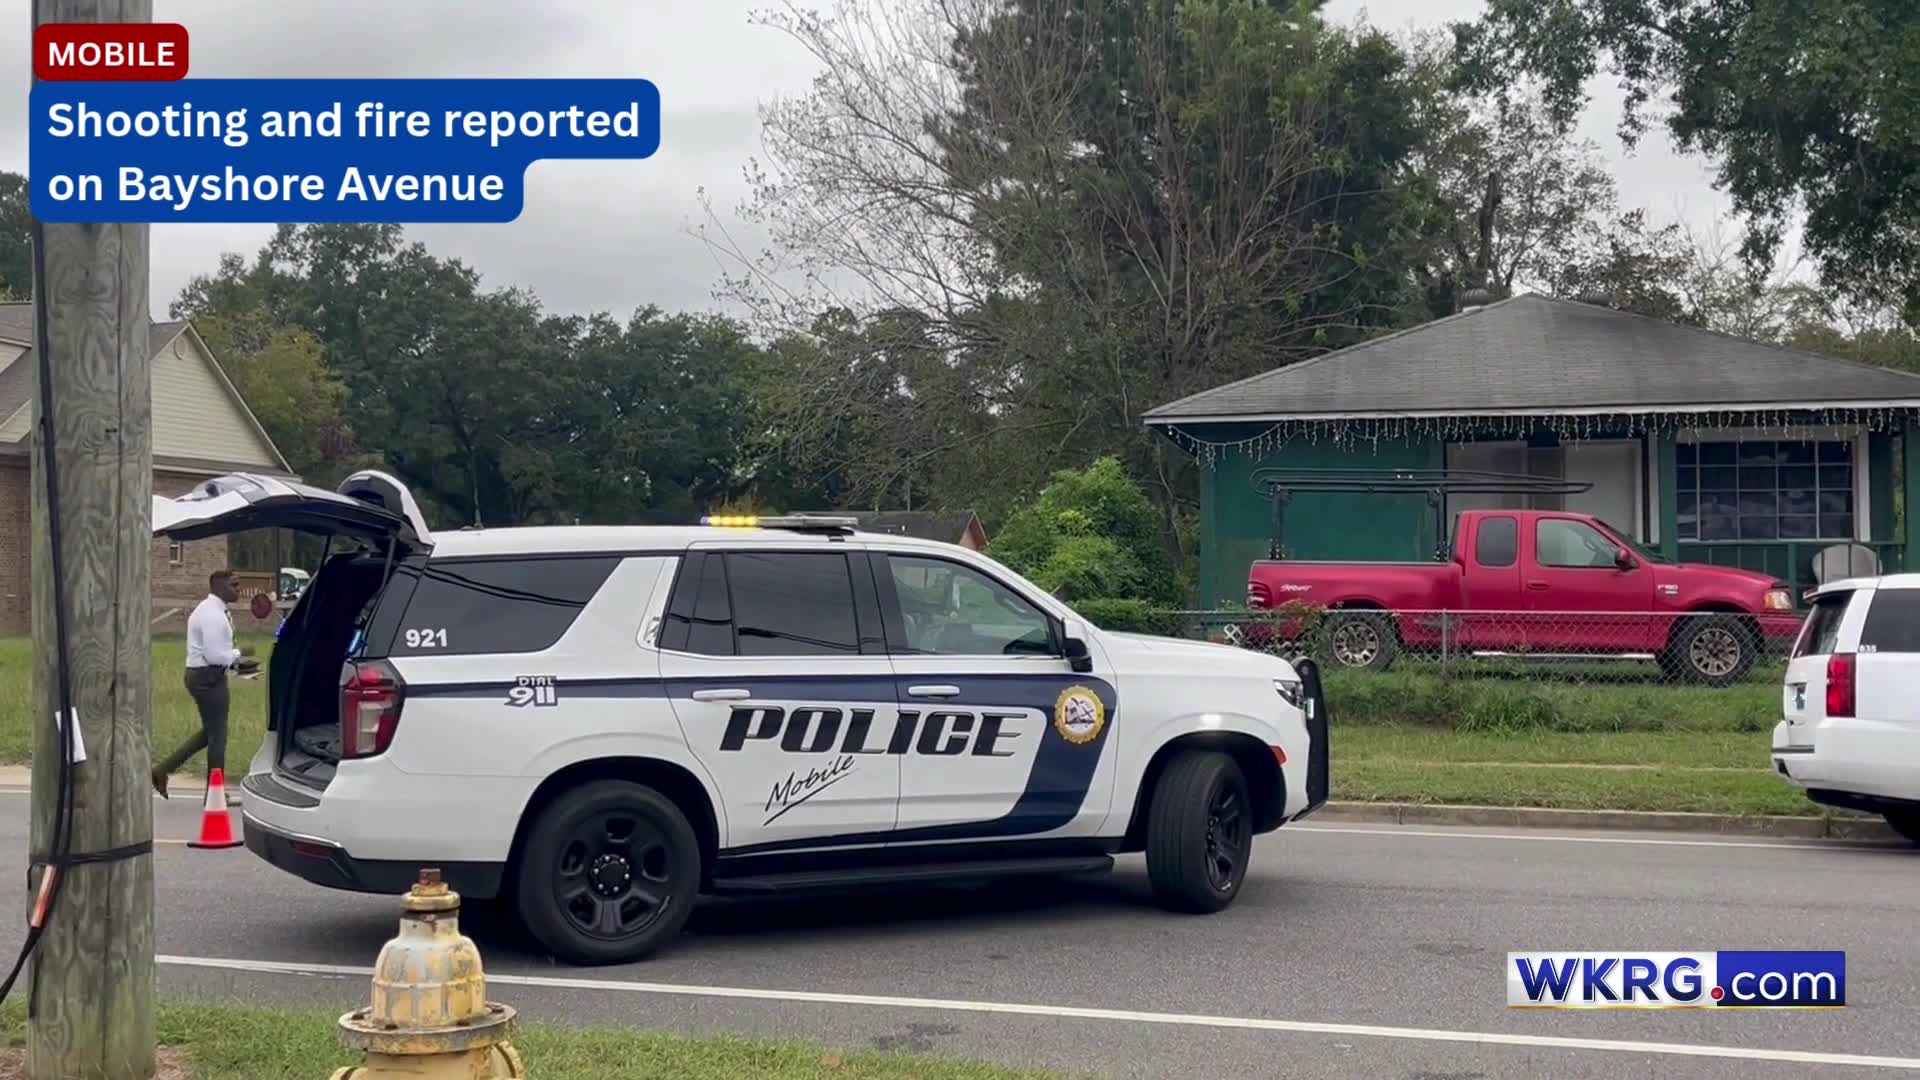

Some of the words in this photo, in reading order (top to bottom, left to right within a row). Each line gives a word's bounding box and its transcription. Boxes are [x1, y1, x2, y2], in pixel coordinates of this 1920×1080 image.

[405, 628, 448, 648] 921
[518, 676, 556, 686] DIAL
[508, 686, 556, 704] 911
[719, 704, 1028, 757] POLICE
[764, 754, 856, 814] Mobile
